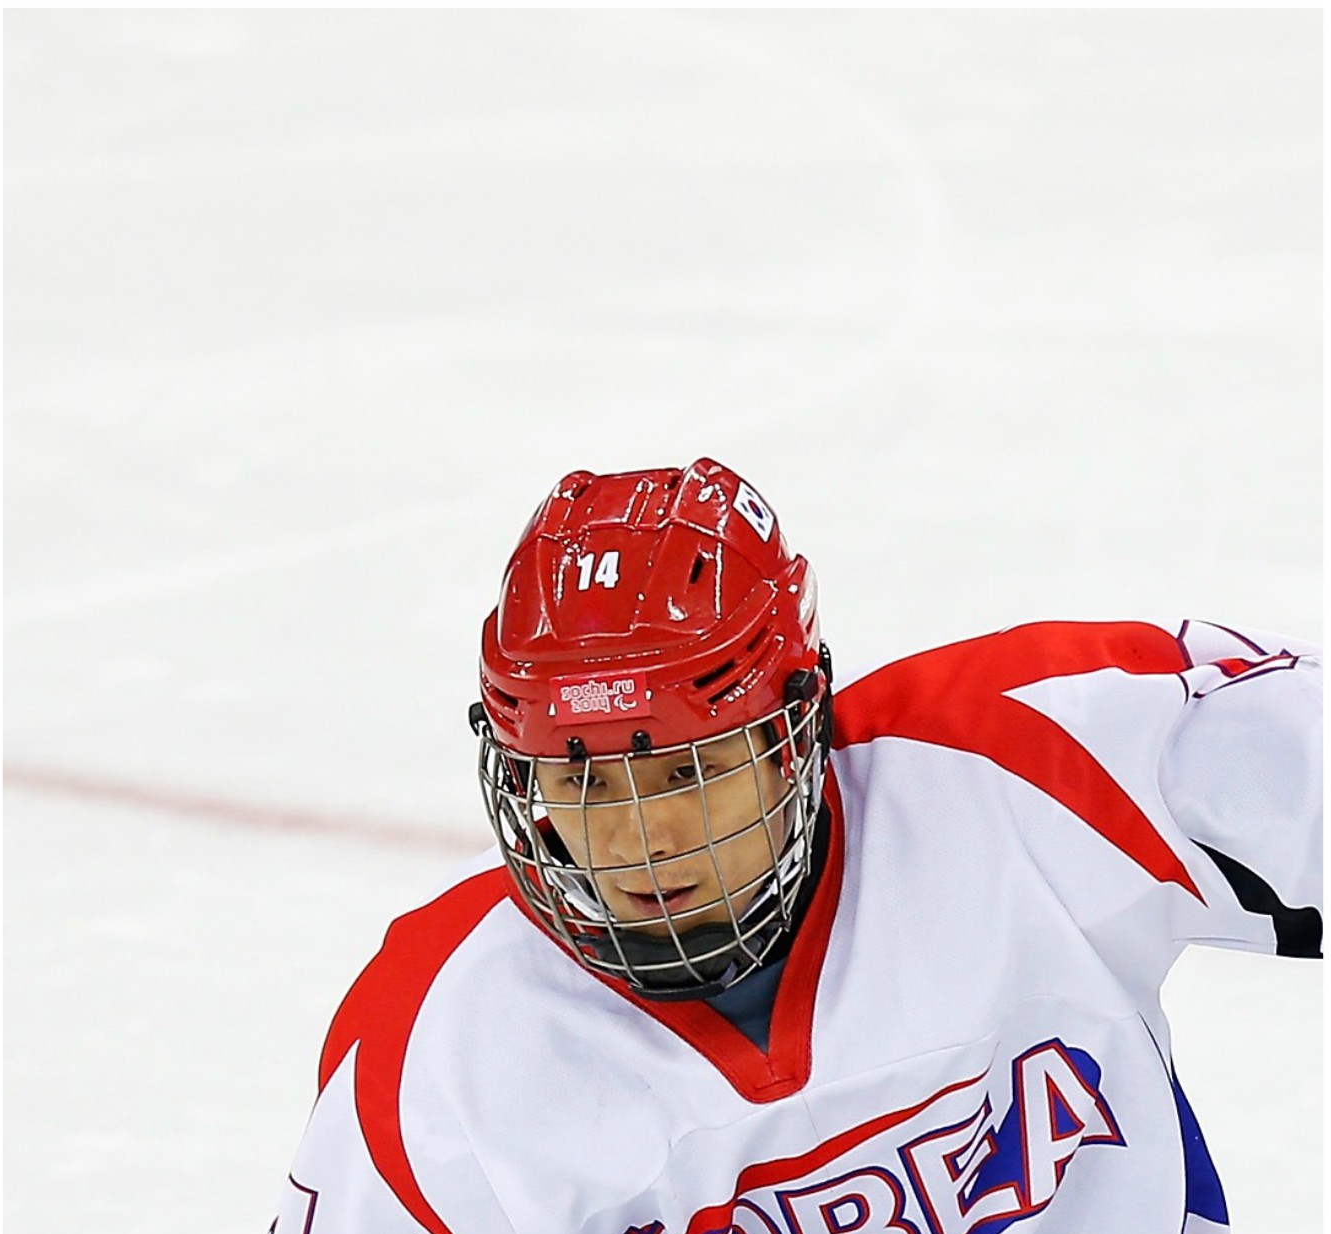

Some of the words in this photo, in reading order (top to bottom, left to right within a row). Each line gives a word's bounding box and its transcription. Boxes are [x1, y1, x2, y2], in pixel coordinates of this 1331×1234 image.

[576, 551, 620, 591] 14
[560, 679, 636, 702] sochi.ru
[570, 696, 612, 714] 2014
